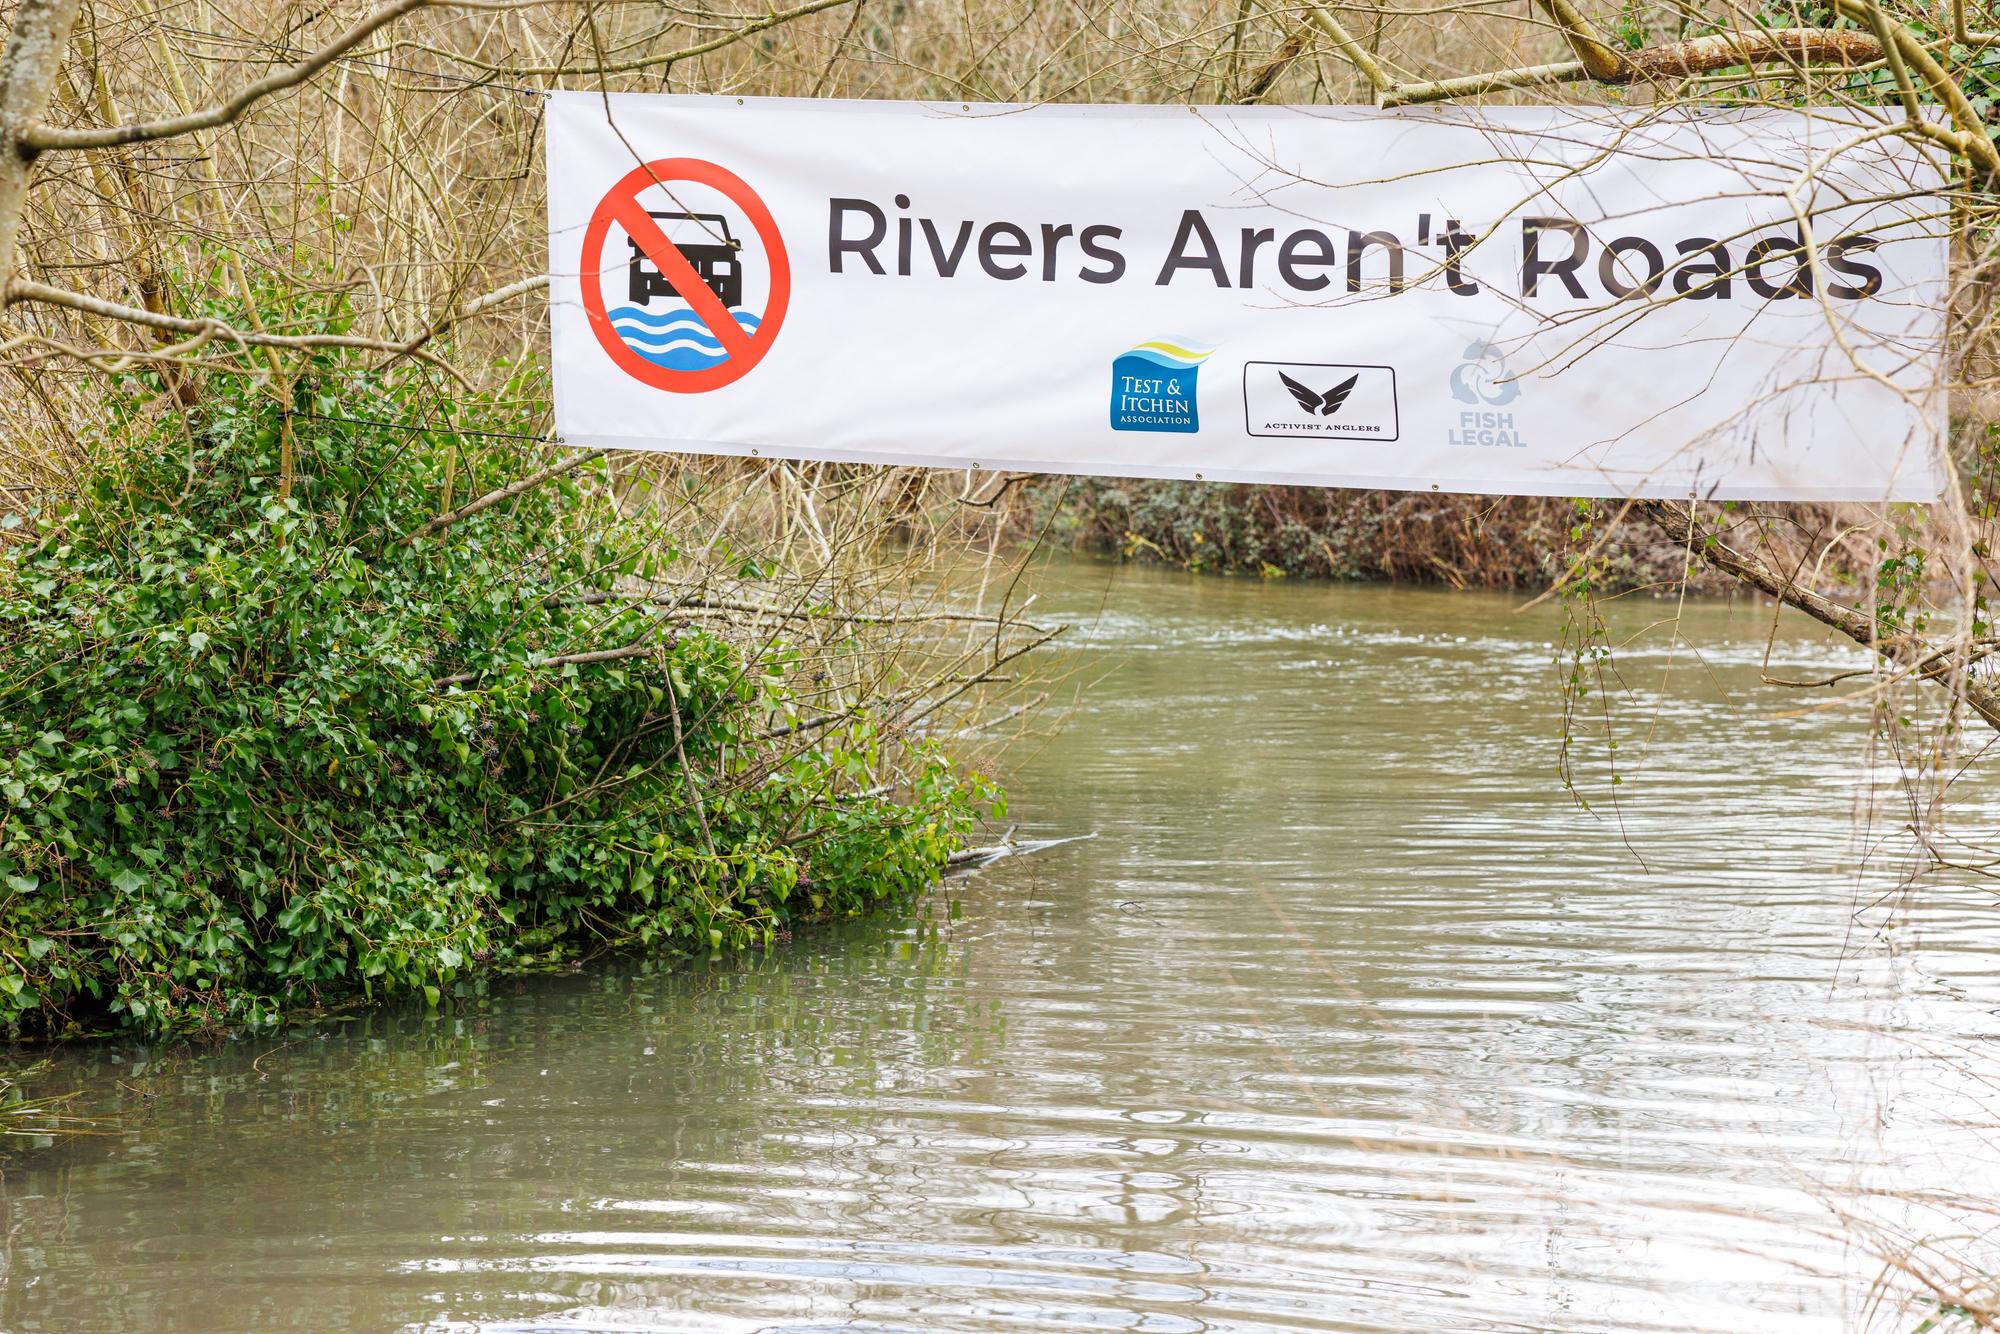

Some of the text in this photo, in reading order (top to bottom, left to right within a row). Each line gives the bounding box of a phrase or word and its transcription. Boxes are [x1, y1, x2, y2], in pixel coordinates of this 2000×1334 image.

[829, 194, 1884, 302] Rivers Aren't Roads
[1122, 376, 1182, 396] TEST &
[1121, 395, 1189, 414] ITCHEN
[1121, 415, 1191, 425] ASSOCIATION
[1264, 422, 1381, 433] ACTIVIST ANGLERS
[1460, 411, 1514, 430] FISH
[1448, 428, 1527, 448] LEGAL
